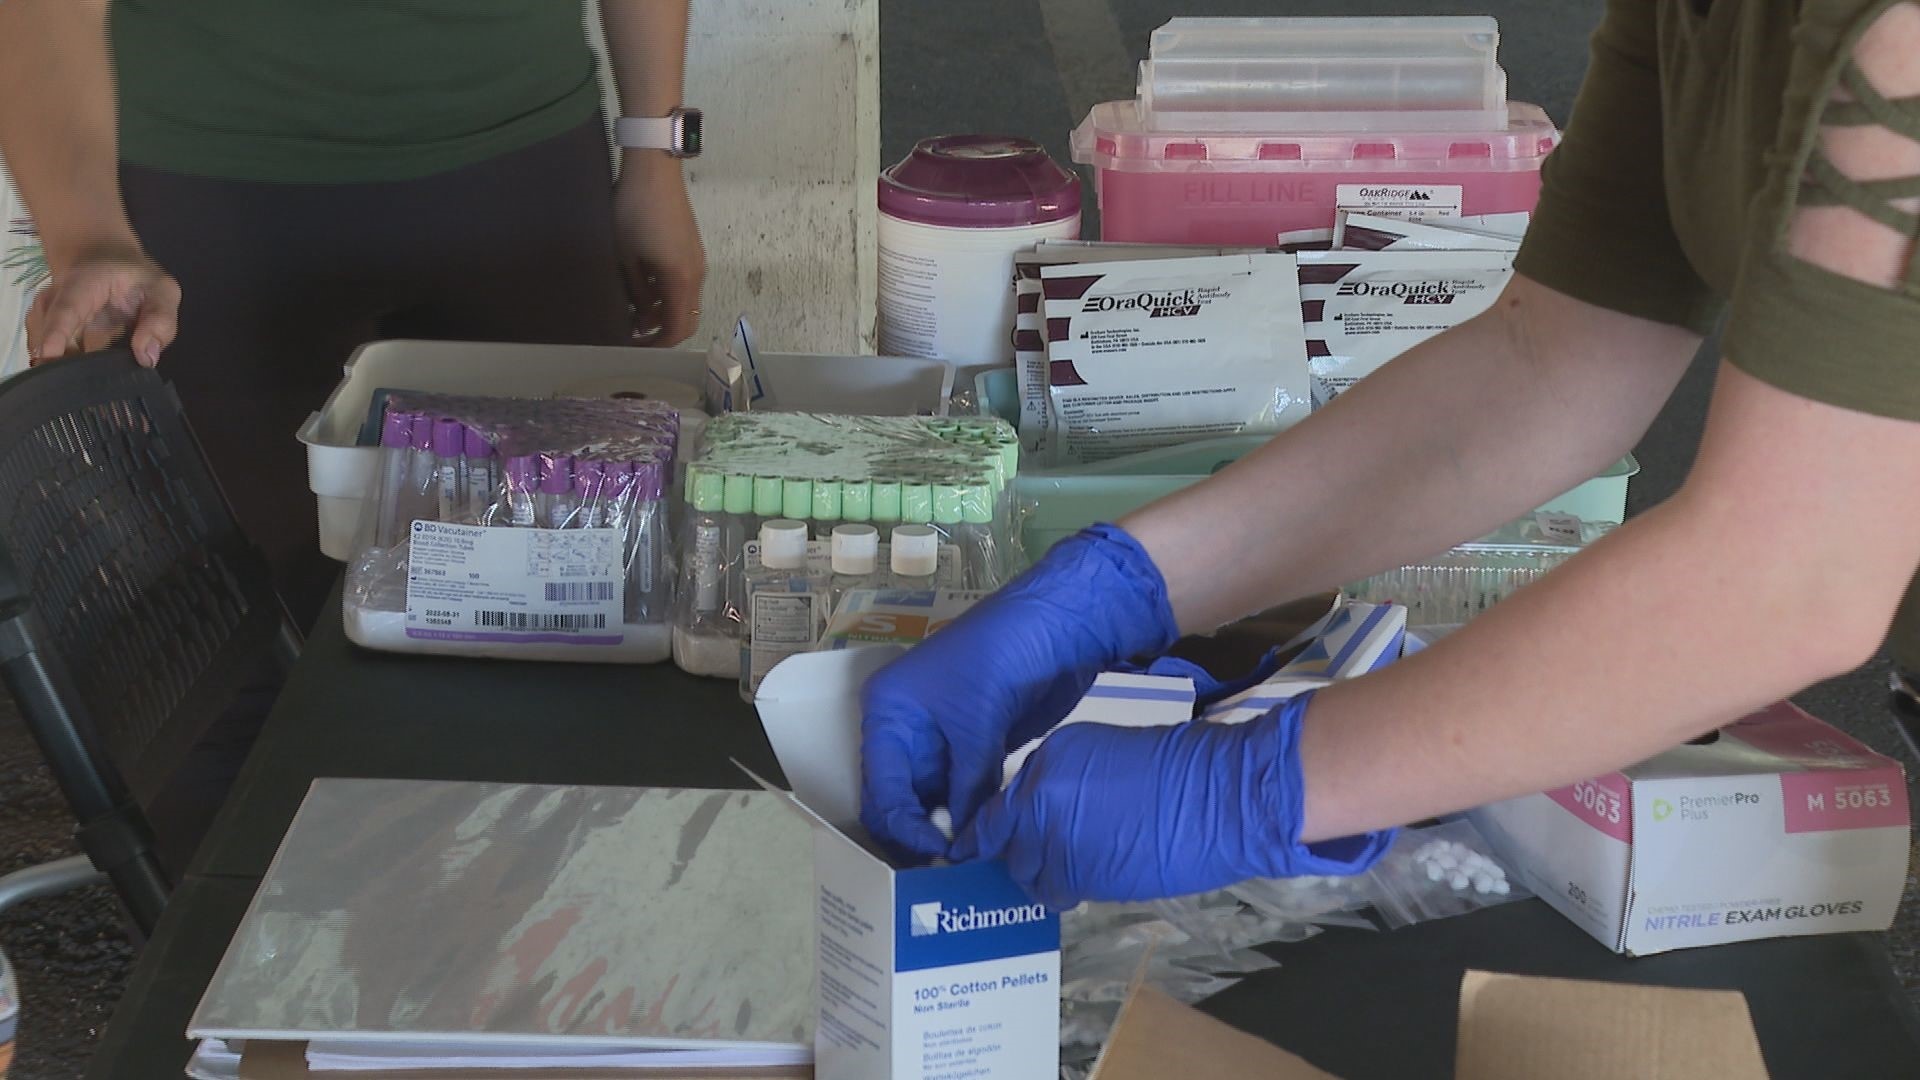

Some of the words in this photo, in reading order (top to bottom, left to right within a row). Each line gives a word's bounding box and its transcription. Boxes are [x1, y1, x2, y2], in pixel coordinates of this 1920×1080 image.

[1184, 181, 1242, 203] FILL
[1251, 181, 1314, 203] LINE
[1353, 280, 1449, 298] OraQuick
[1099, 290, 1194, 311] OraQuick
[1413, 294, 1447, 304] HCV
[1159, 305, 1194, 318] HCV
[424, 523, 437, 534] BD
[438, 525, 483, 538] Vacutainer
[1679, 791, 1761, 809] PremierPro
[1807, 793, 1824, 812] M
[1834, 788, 1891, 810] 5063
[1679, 807, 1709, 820] Plus
[1644, 912, 1721, 932] NITRILE
[1725, 907, 1781, 926] EXAM
[1784, 900, 1863, 920] GLOVES
[949, 978, 998, 997] Cotton
[1000, 970, 1049, 989] Pellets
